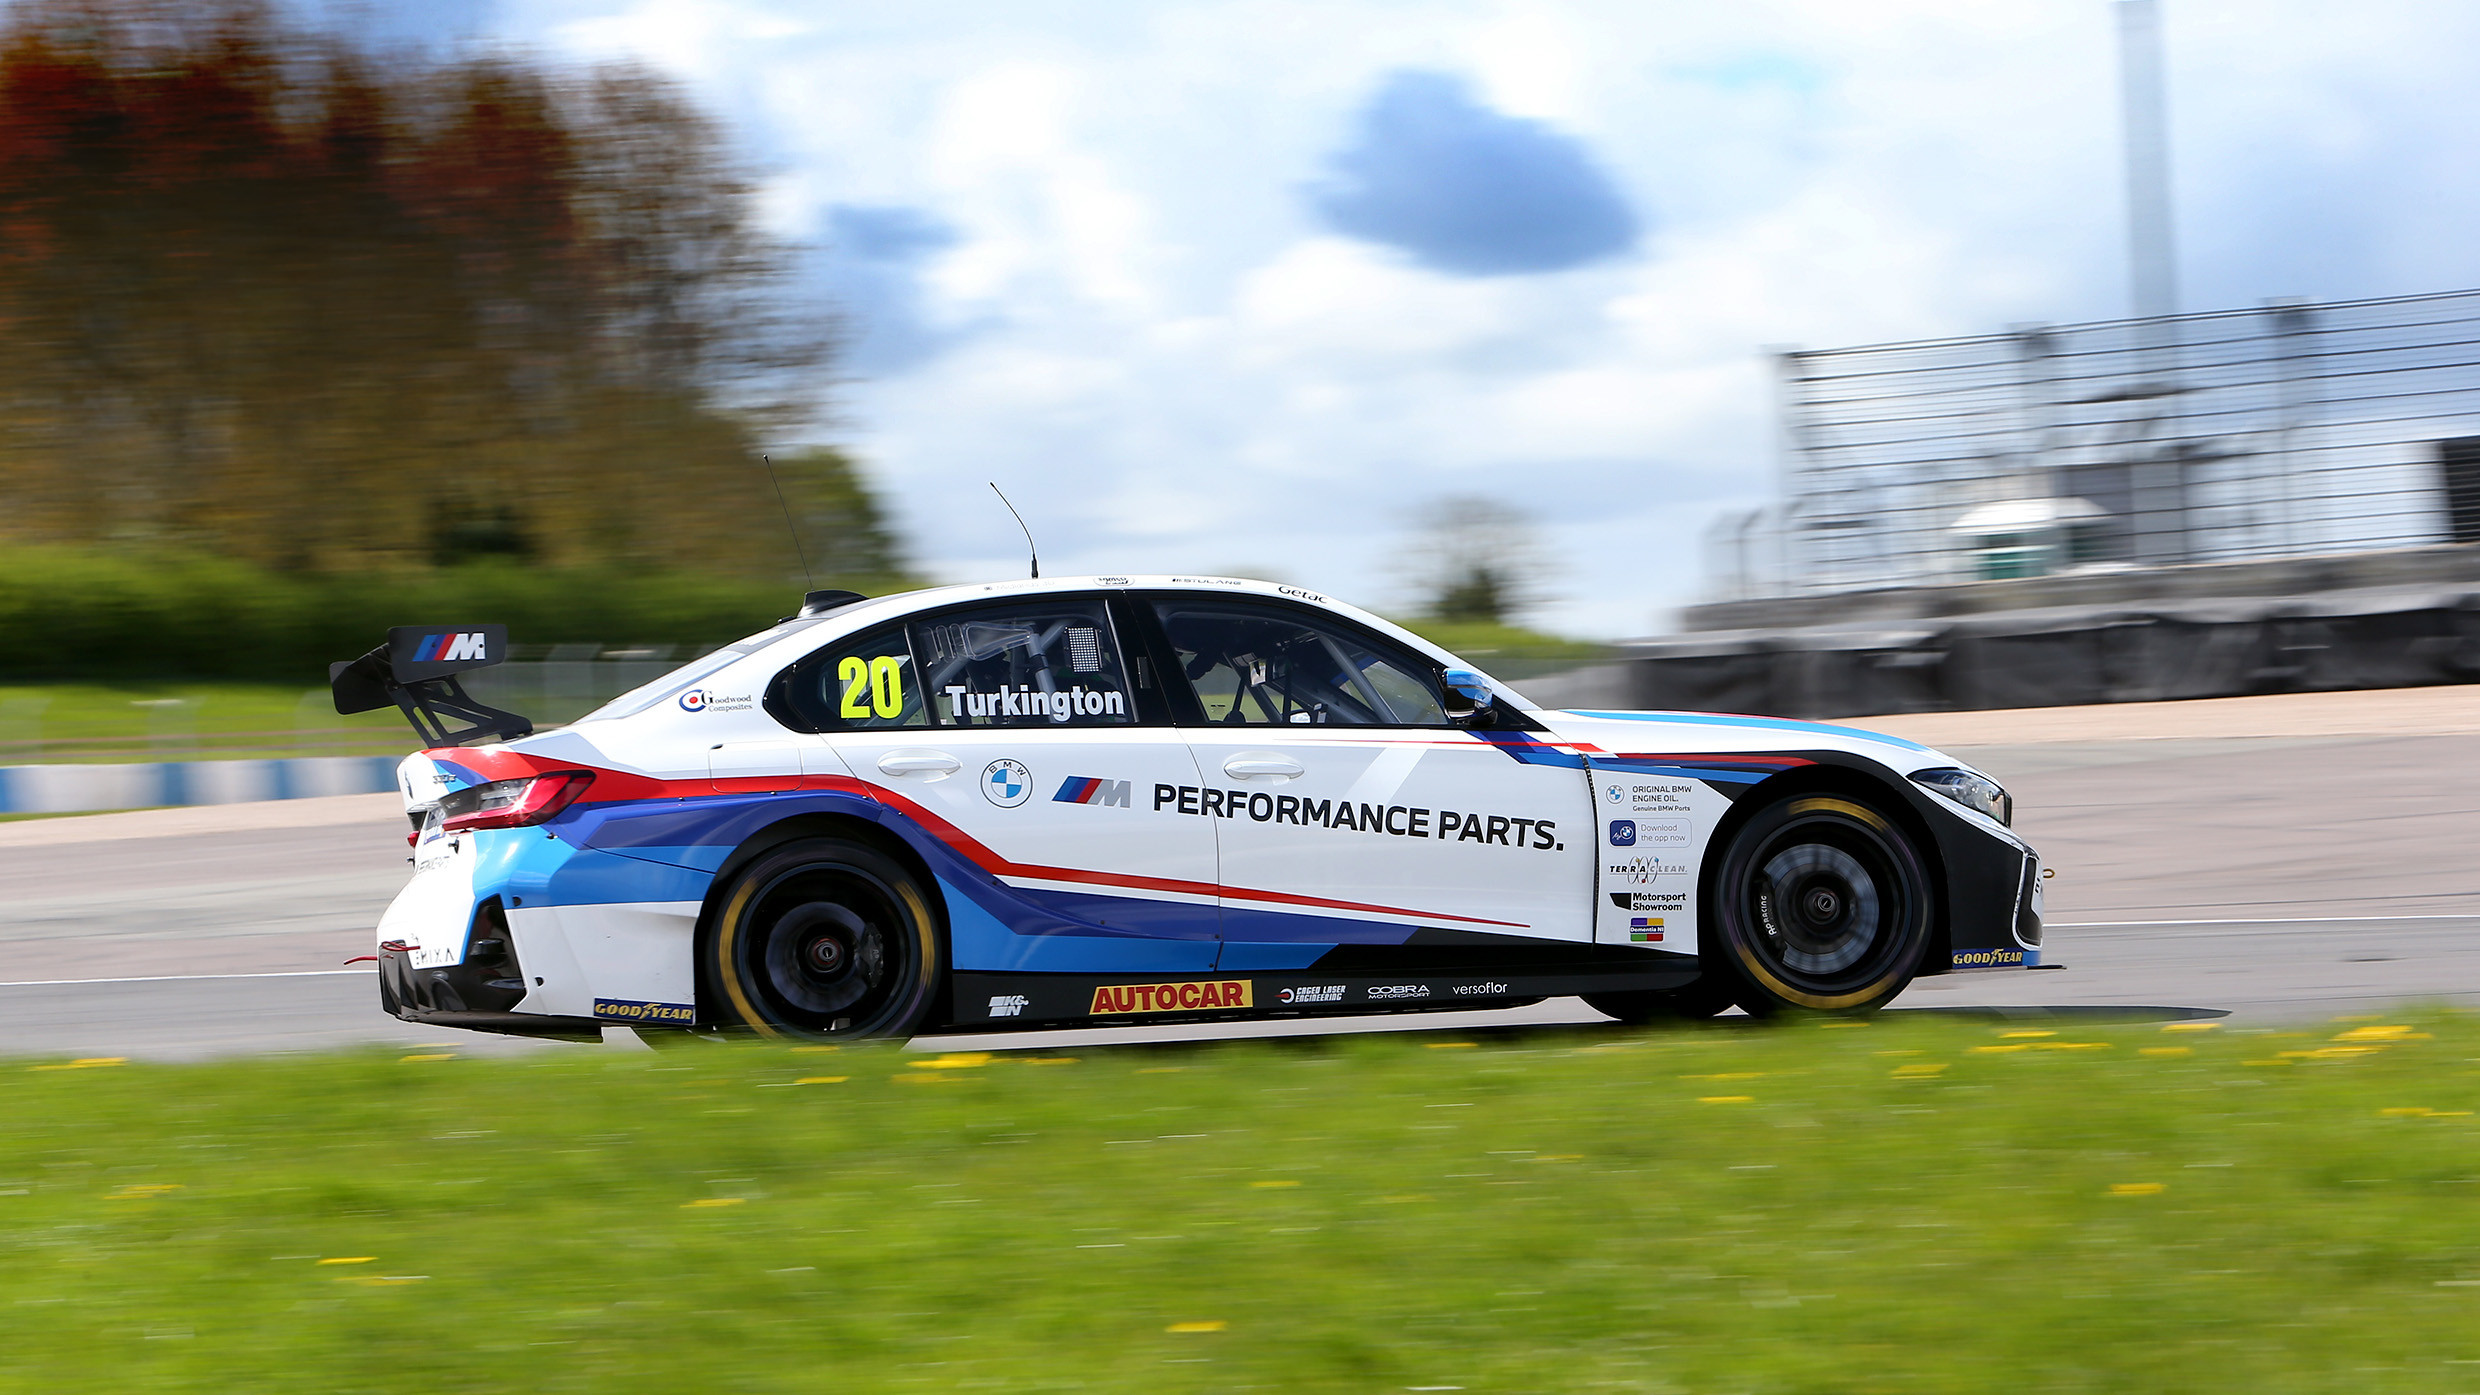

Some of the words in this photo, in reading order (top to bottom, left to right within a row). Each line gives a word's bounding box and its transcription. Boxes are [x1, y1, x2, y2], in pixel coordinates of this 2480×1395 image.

[1278, 585, 1328, 604] Getac
[838, 655, 903, 719] 20
[701, 690, 751, 705] Goodwood
[945, 684, 1124, 722] Turkington
[708, 704, 753, 712] Composites
[1632, 785, 1670, 793] ORIGINAL
[1672, 785, 1692, 793] BMW
[1153, 783, 1430, 838] PERFORMANCE
[1438, 809, 1565, 852] PARTS.
[1633, 893, 1686, 902] Motorsport
[1633, 903, 1683, 911] Showroom
[1760, 895, 1770, 923] RACING
[1953, 949, 2023, 966] GOODYEAR
[1323, 985, 1347, 993] LASER
[1367, 984, 1431, 994] COBRA
[1452, 981, 1508, 995] versoflor
[1093, 982, 1244, 1013] AUTOCAR
[1295, 993, 1342, 1003] ENGINEERING
[1367, 992, 1431, 1000] MOTORSPORT
[595, 1001, 693, 1022] GOODYEAR
